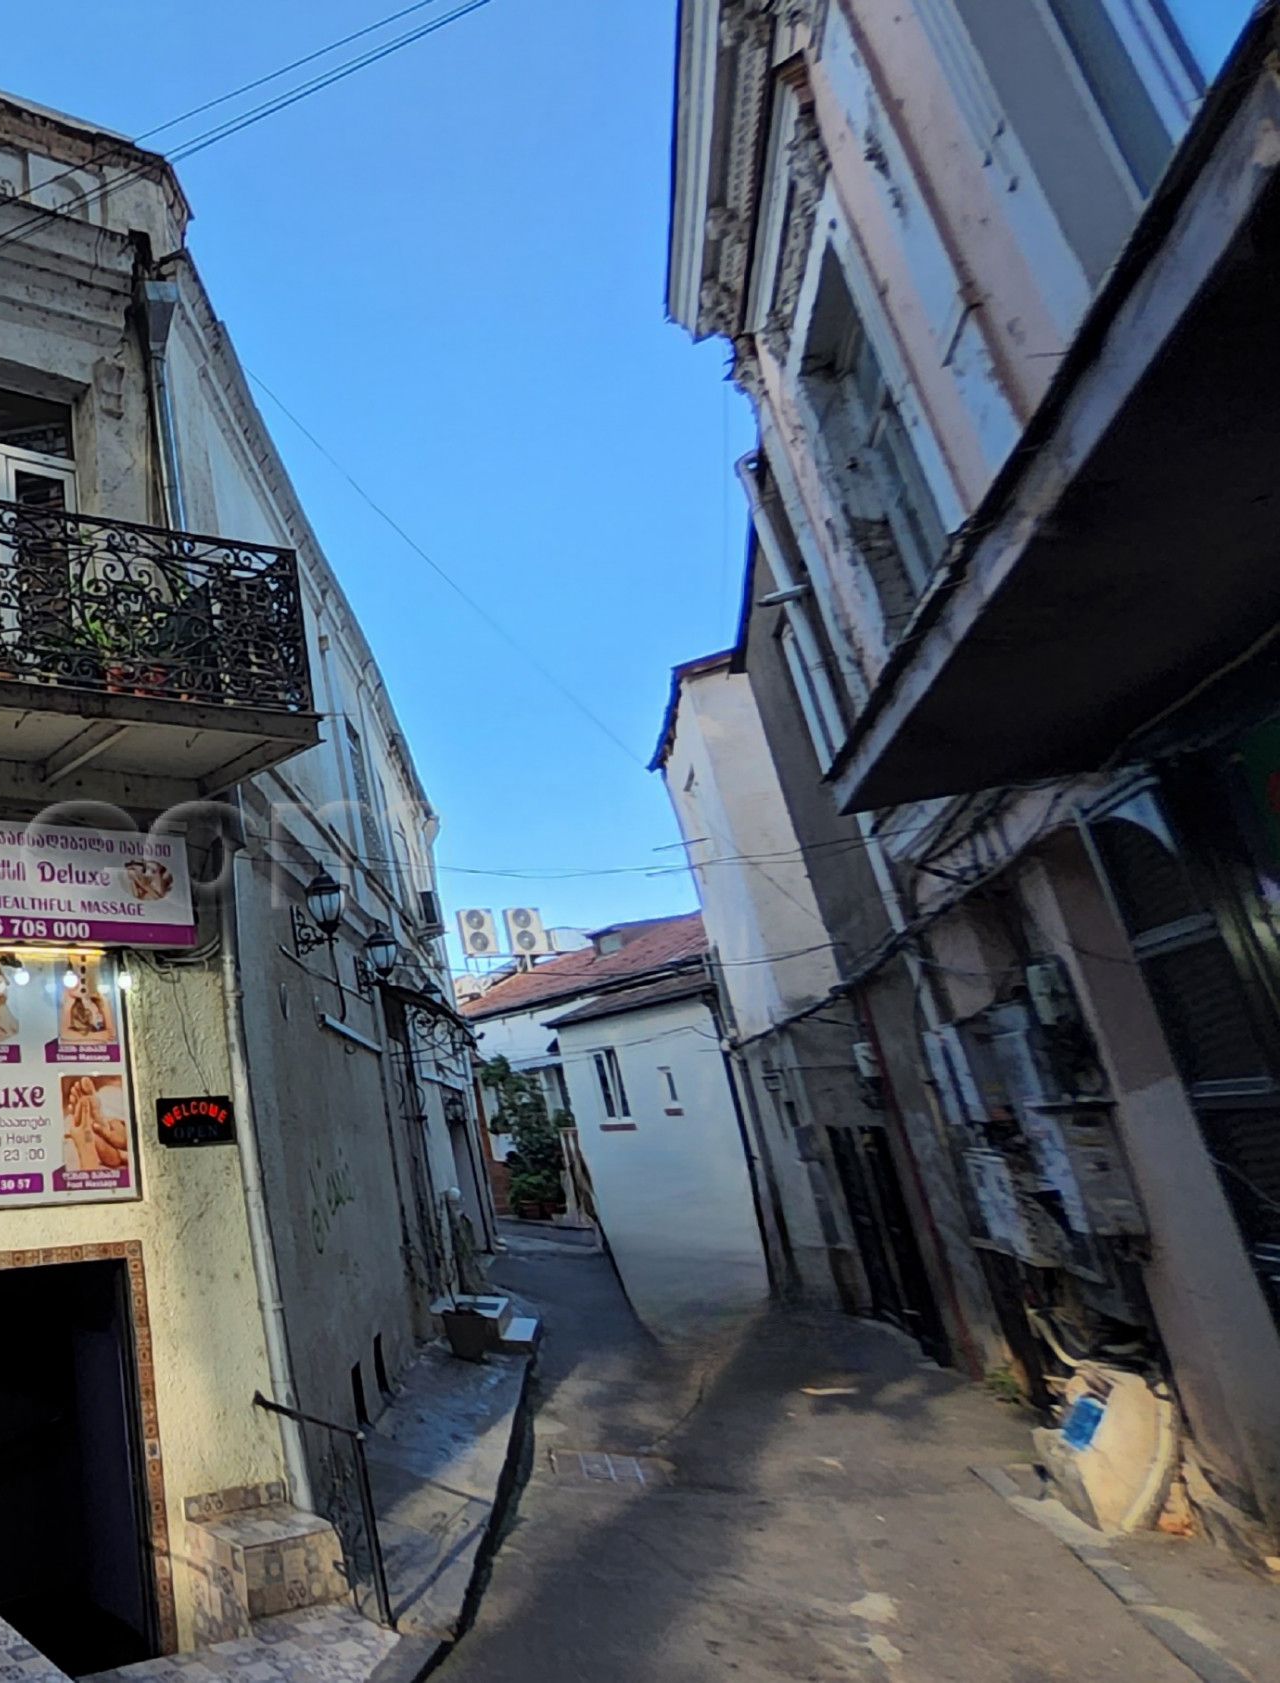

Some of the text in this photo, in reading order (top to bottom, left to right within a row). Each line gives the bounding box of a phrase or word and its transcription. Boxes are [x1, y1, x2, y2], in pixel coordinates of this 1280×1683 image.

[36, 860, 111, 887] Deluxe
[80, 900, 145, 917] MASSAGE
[10, 918, 47, 937] 708
[53, 921, 90, 939] 000
[162, 1101, 228, 1127] WELCOME
[6, 1133, 42, 1144] Hours
[174, 1125, 218, 1138] OPEN
[0, 1179, 15, 1190] 30
